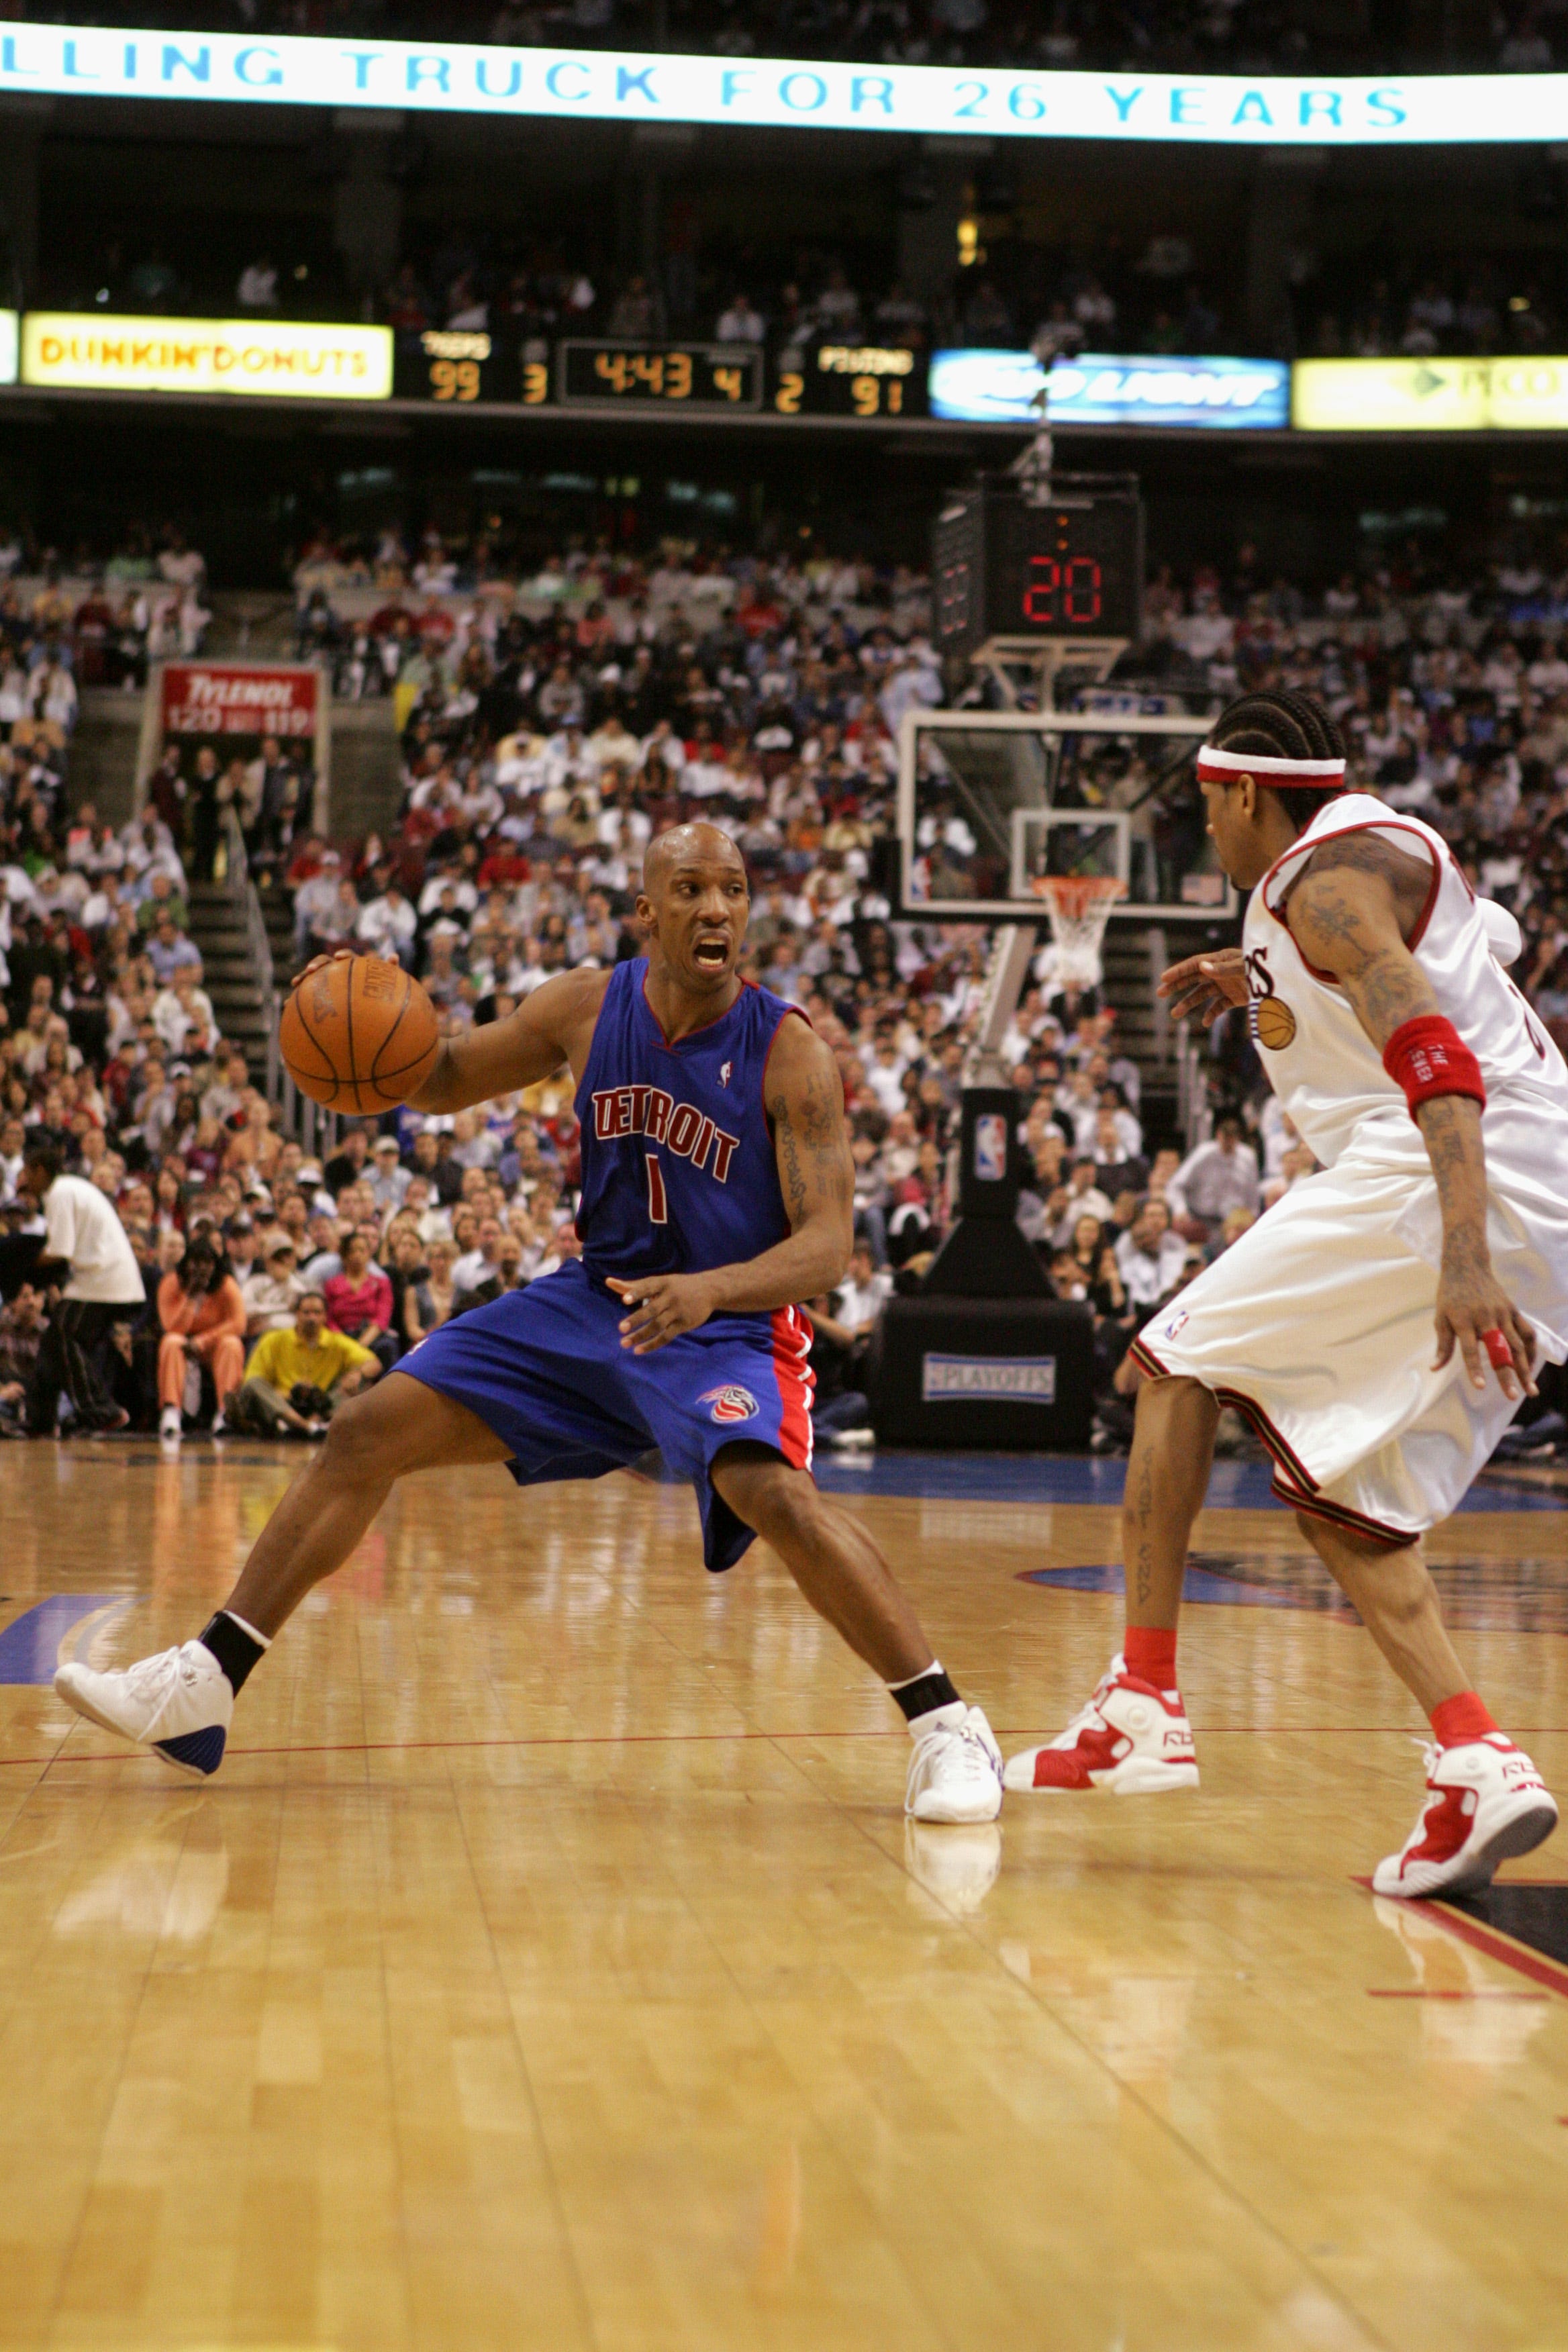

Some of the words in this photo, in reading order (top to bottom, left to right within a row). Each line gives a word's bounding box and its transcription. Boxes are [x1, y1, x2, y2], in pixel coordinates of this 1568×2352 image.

[1, 36, 284, 87] LLING
[341, 52, 660, 103] TRUCK
[720, 70, 895, 115] FOR
[952, 81, 1048, 120] 26
[1104, 85, 1408, 128] YEARS
[213, 345, 368, 378] DONUTS
[430, 360, 480, 401] 99
[524, 363, 547, 403] 3
[595, 352, 692, 398] 4:43
[714, 367, 741, 401] 4
[776, 373, 804, 413] 2
[852, 375, 902, 415] 91
[1023, 556, 1101, 622] 20
[592, 1085, 740, 1183] DETROIT
[645, 1153, 668, 1224] 1
